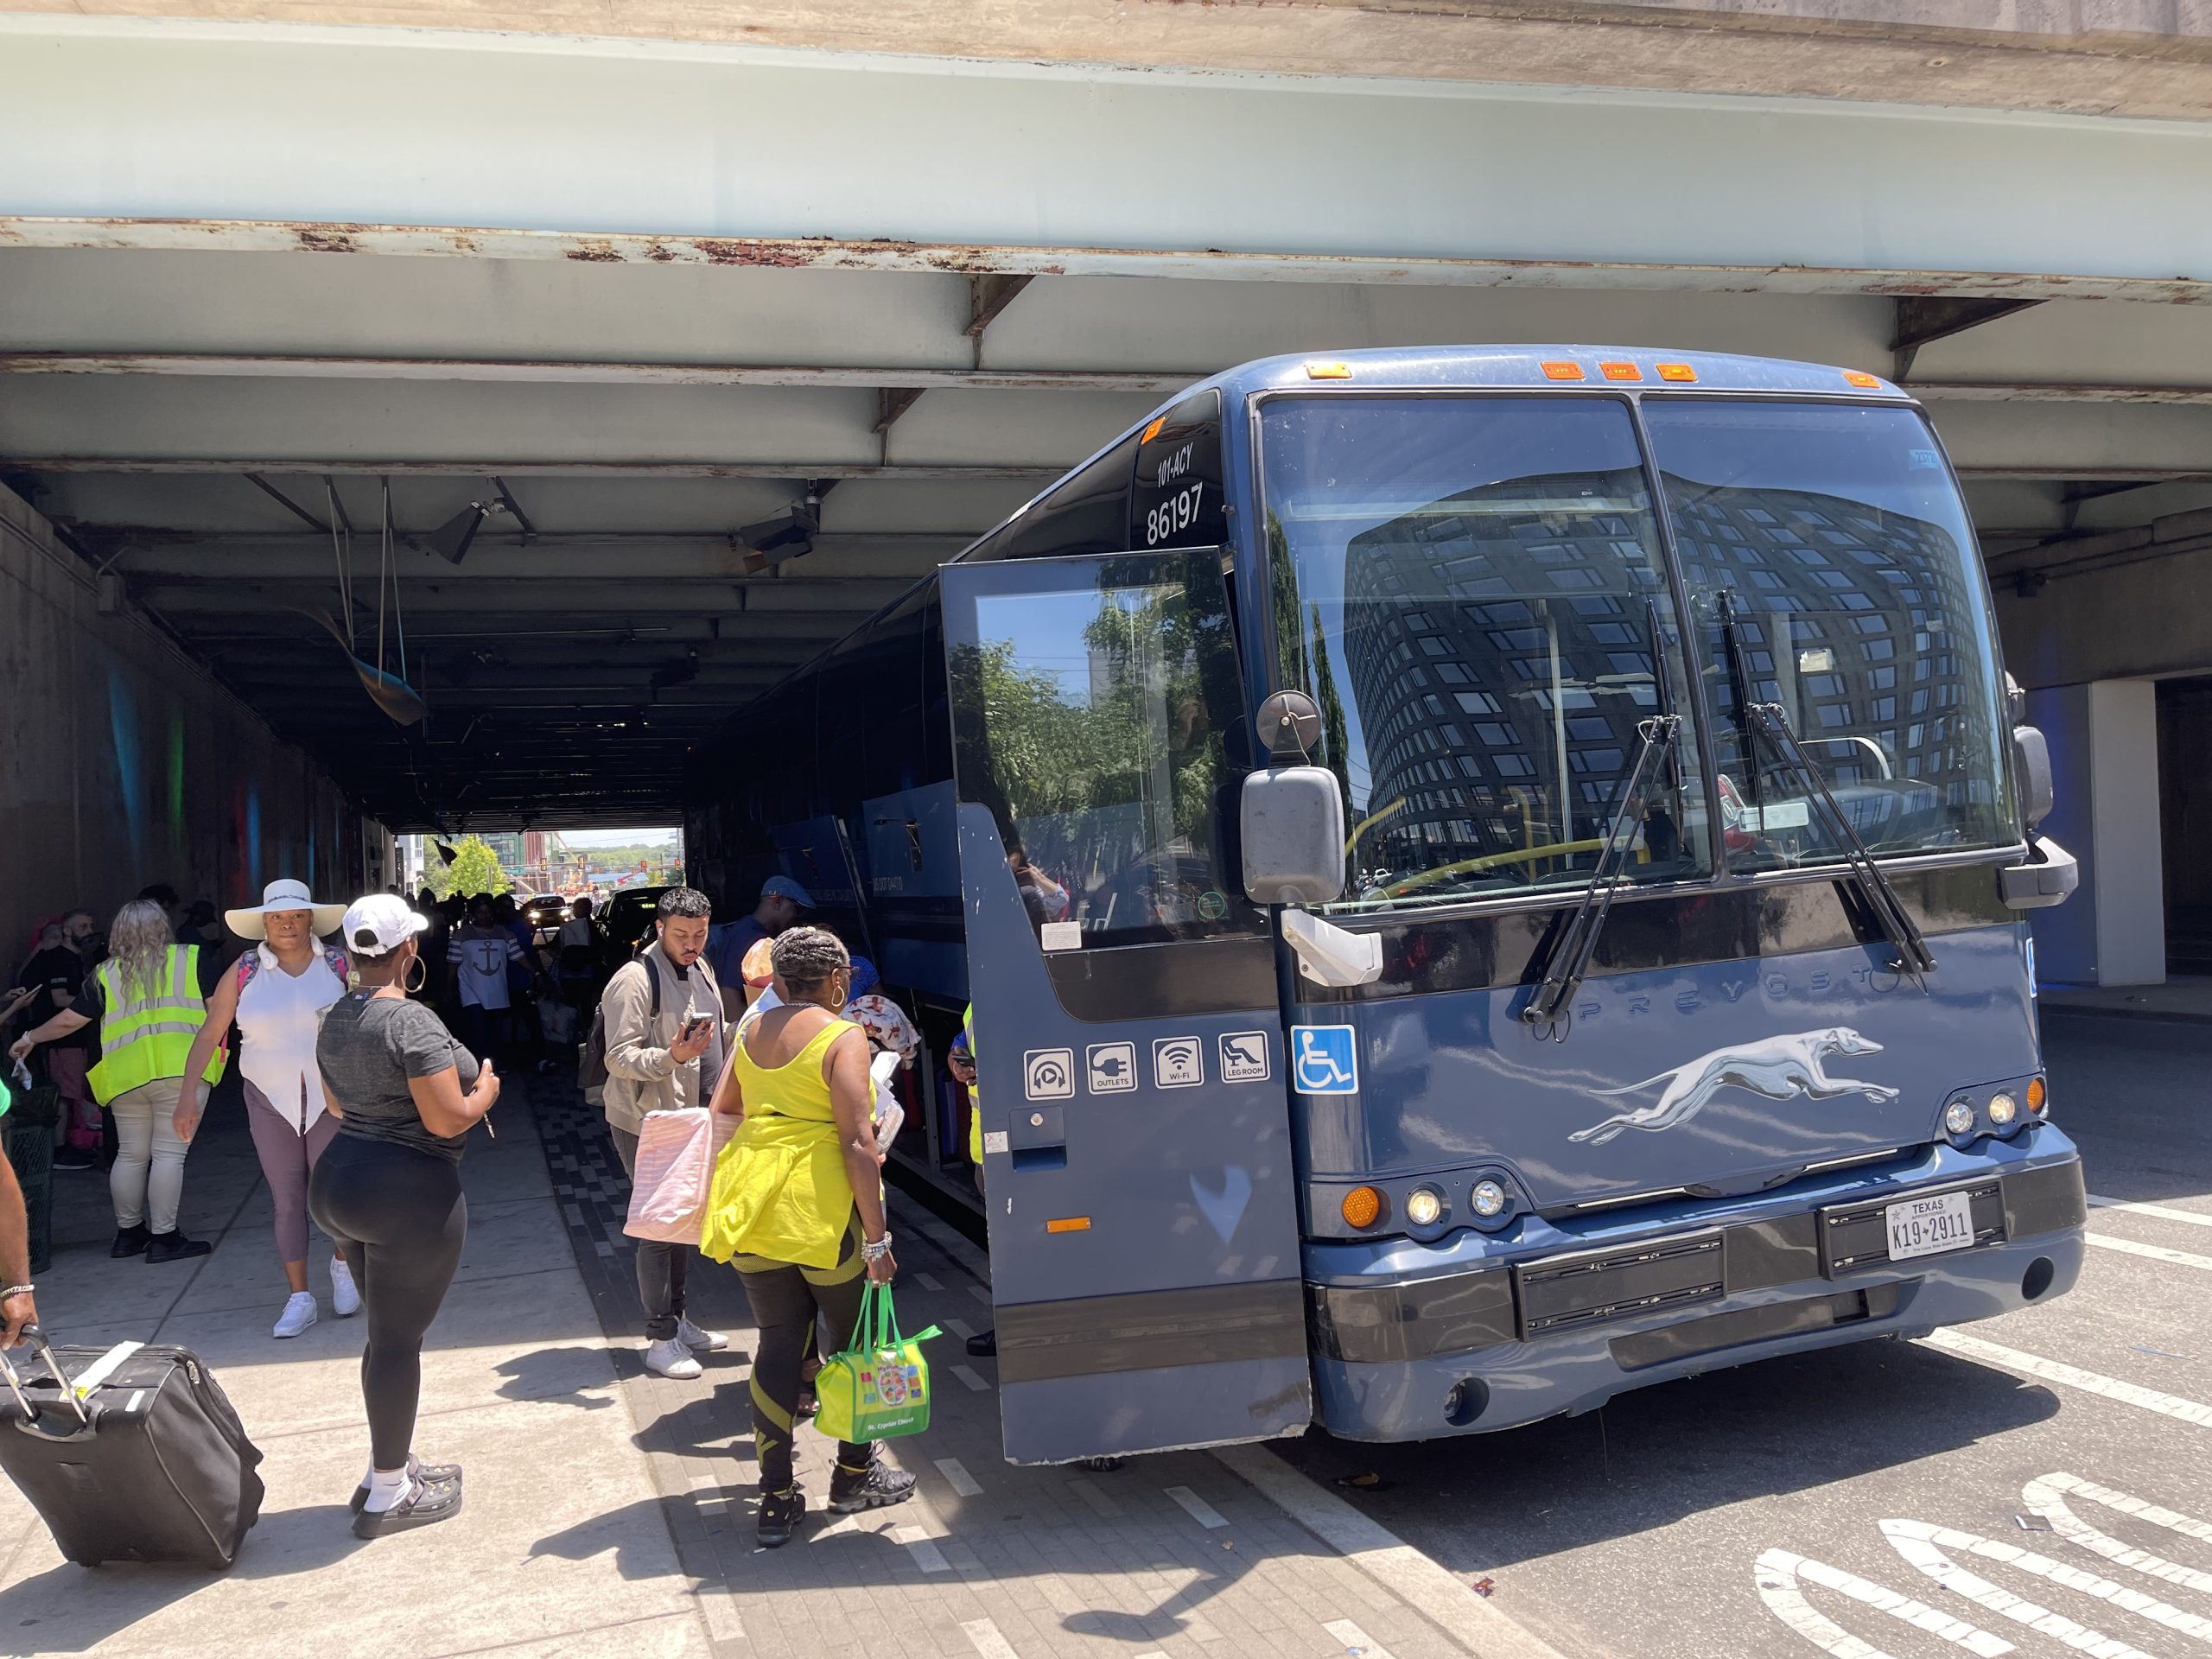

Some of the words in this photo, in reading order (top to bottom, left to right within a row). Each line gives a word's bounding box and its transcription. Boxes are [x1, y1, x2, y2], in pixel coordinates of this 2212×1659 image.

[1158, 442, 1193, 488] 101-ACY
[1147, 480, 1203, 546] 86197
[1578, 963, 1872, 1021] PREVOST
[1169, 1071, 1190, 1080] Wi-Fi
[1227, 1068, 1242, 1077] LEG
[1242, 1067, 1263, 1076] ROOM
[1096, 1077, 1129, 1087] OUTLETS
[1912, 1199, 1943, 1215] TEXAS
